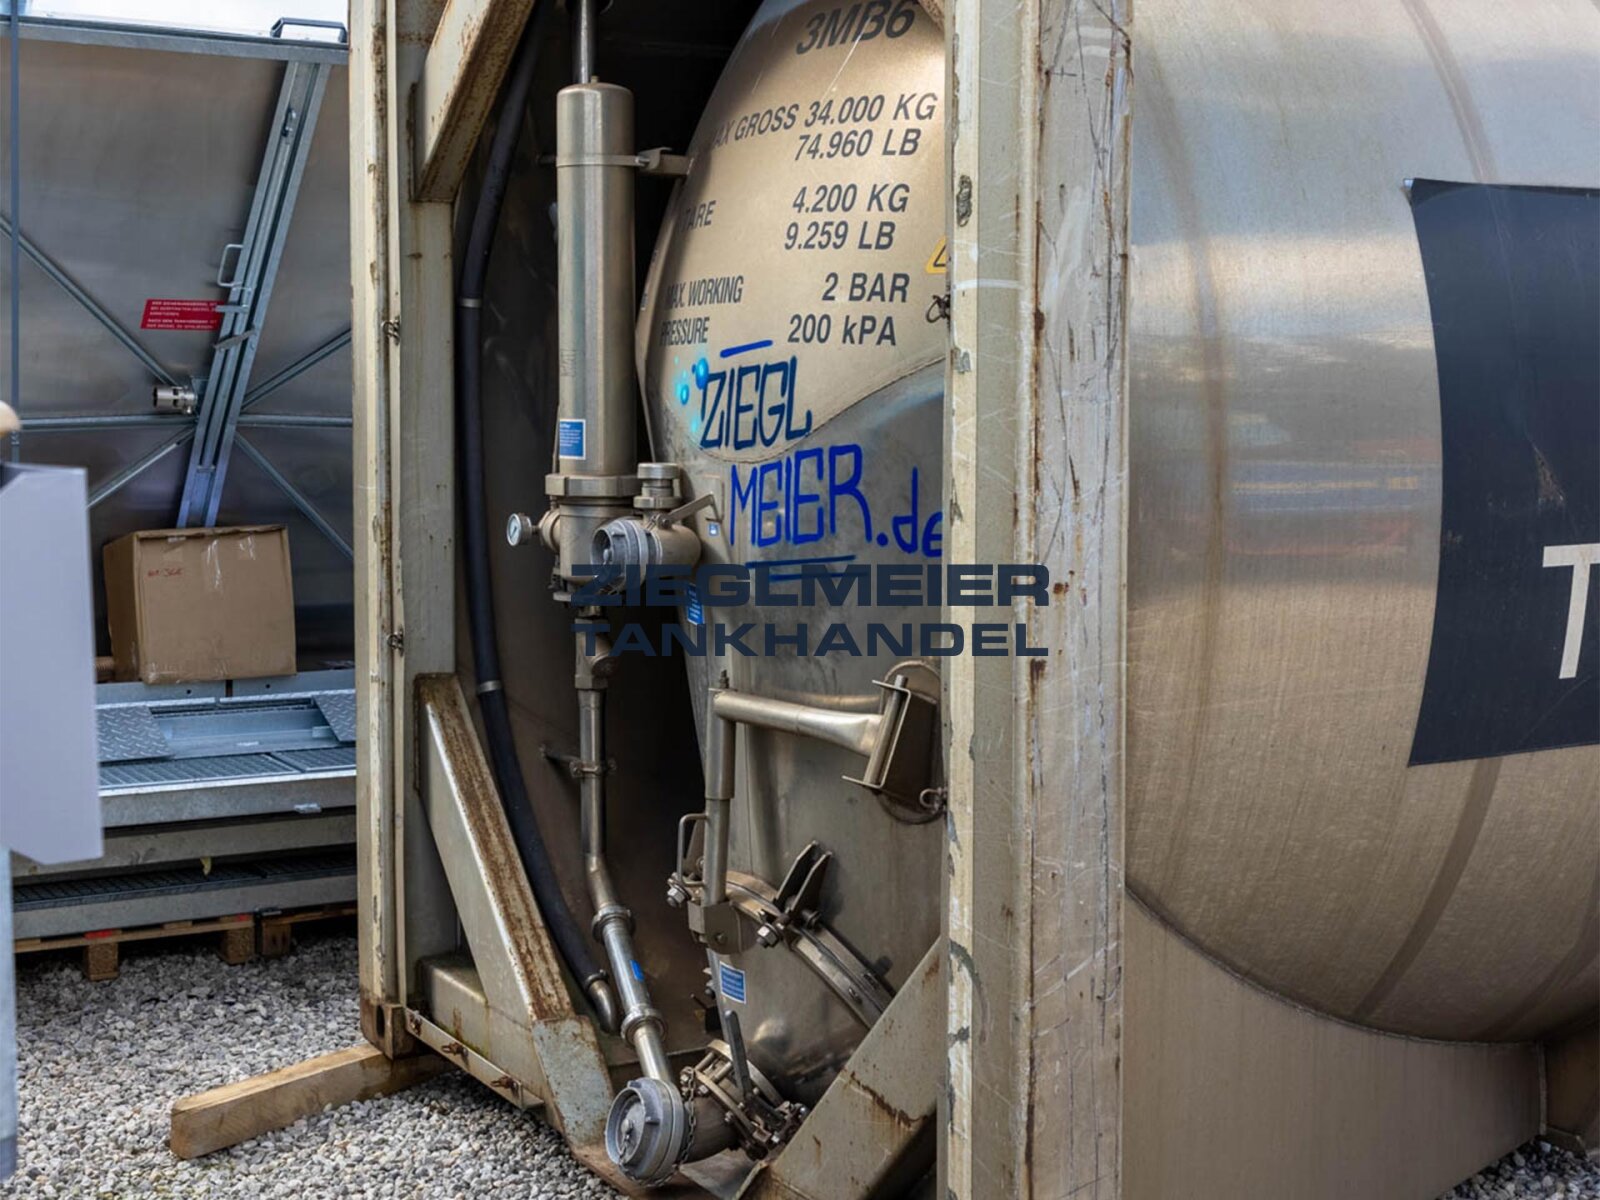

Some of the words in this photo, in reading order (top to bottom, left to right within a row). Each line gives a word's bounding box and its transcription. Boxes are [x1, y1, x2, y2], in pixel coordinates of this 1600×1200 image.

[796, 0, 915, 54] 3MB6
[734, 104, 799, 141] GROSS
[804, 94, 884, 127] 34.000
[893, 92, 938, 121] KG
[794, 129, 873, 161] 74.960
[882, 128, 922, 156] LB
[792, 183, 857, 213] 4.200
[866, 183, 910, 213] KG
[784, 221, 848, 250] 9.259
[857, 221, 896, 250] LB
[688, 275, 744, 307] WORKING
[821, 272, 839, 301] 2
[848, 272, 910, 303] BAR
[660, 317, 710, 347] PRESSURE
[787, 314, 831, 344] 200
[841, 315, 896, 346] kPA
